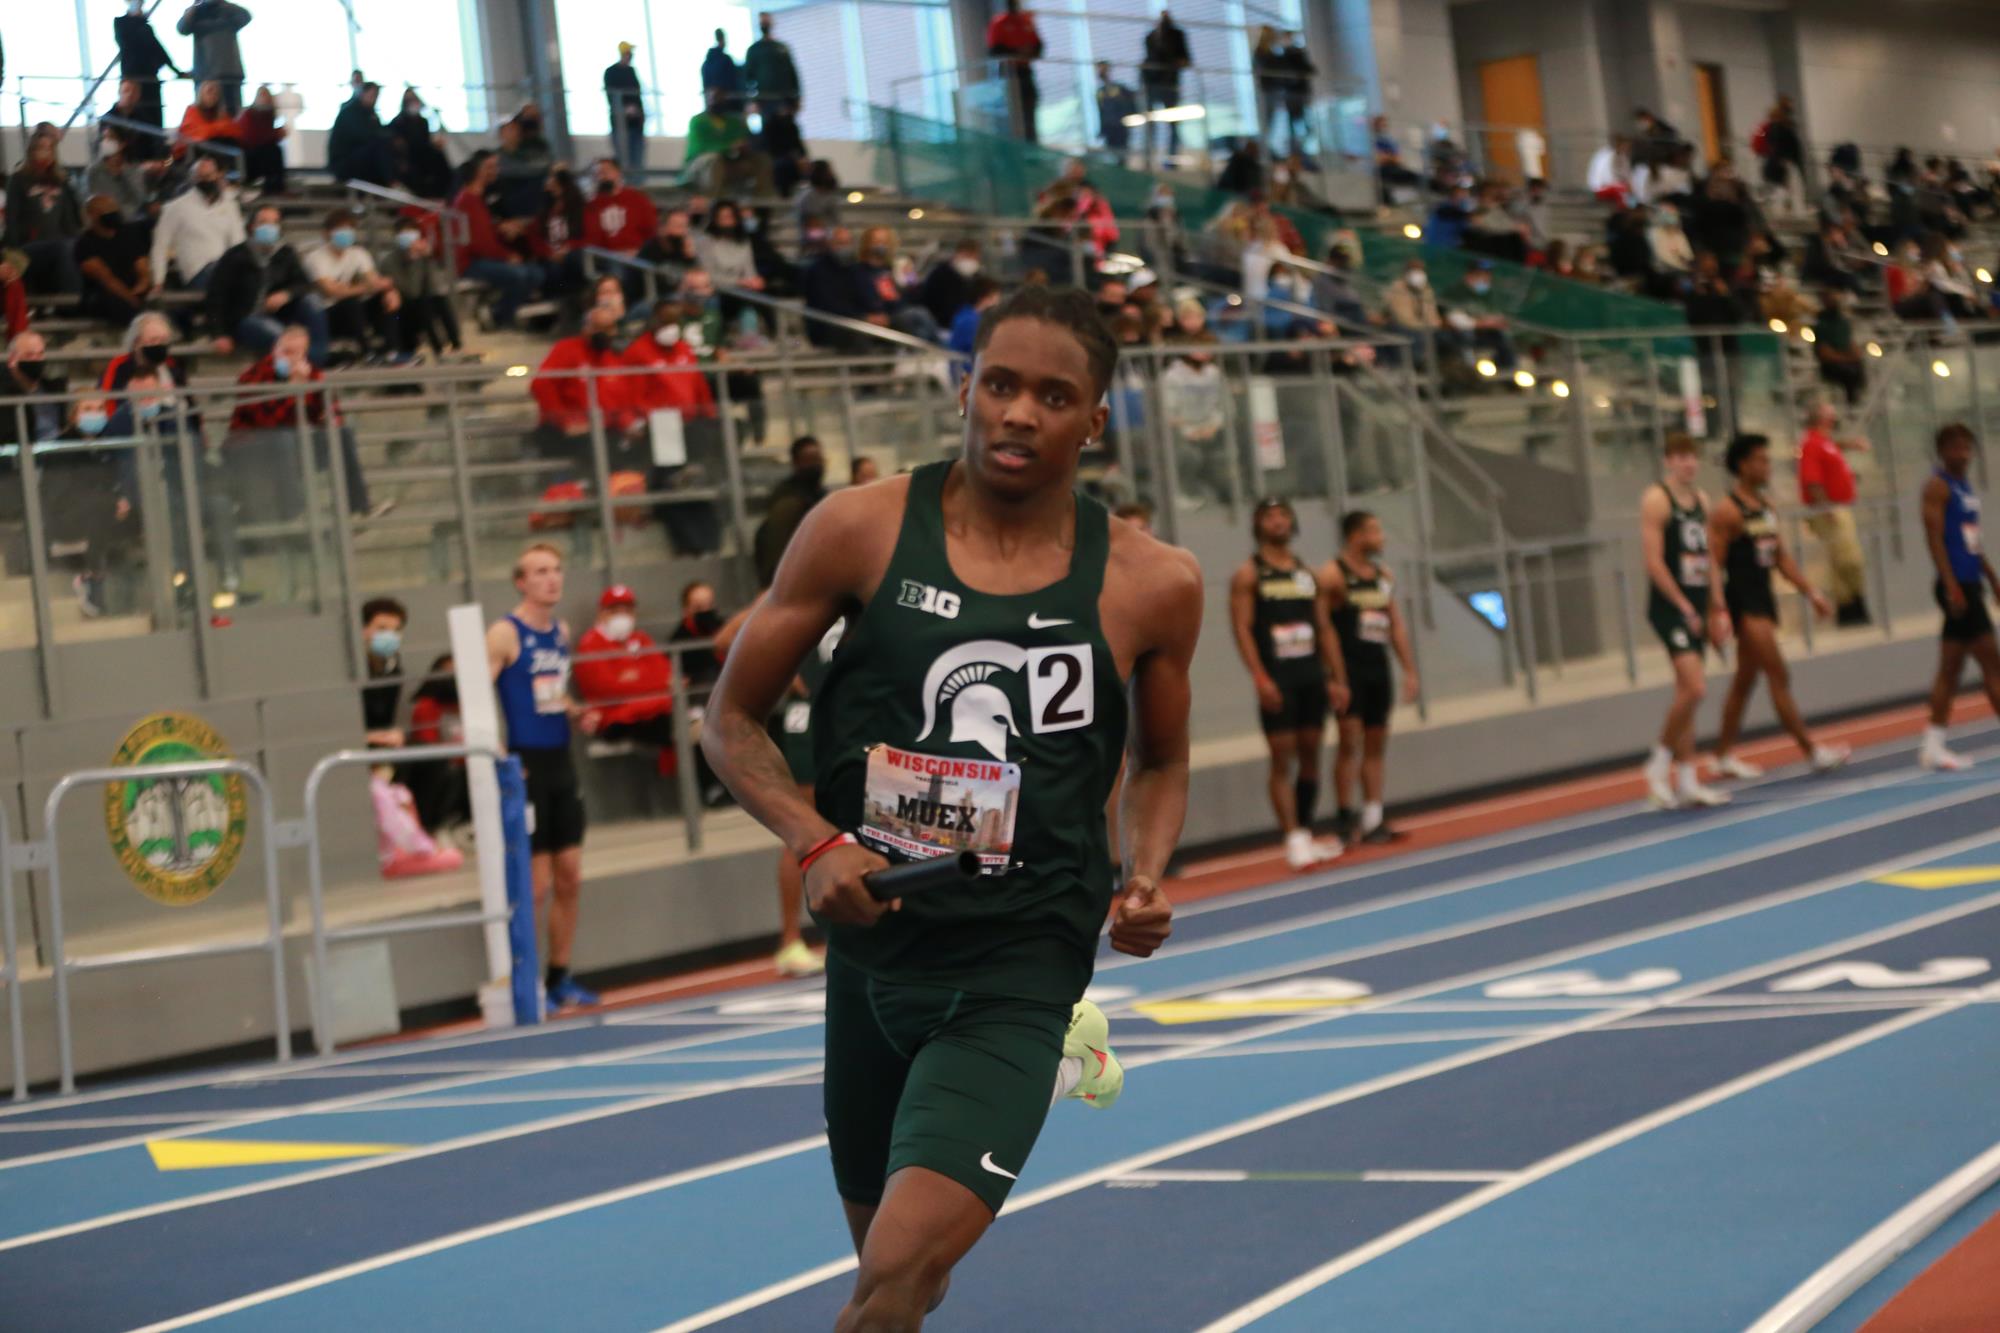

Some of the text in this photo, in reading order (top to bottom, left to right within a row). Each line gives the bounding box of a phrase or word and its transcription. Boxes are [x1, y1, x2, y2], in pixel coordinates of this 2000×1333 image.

[1038, 653, 1085, 727] 2
[886, 749, 1003, 782] WISCONSIN
[897, 794, 978, 833] MUEX
